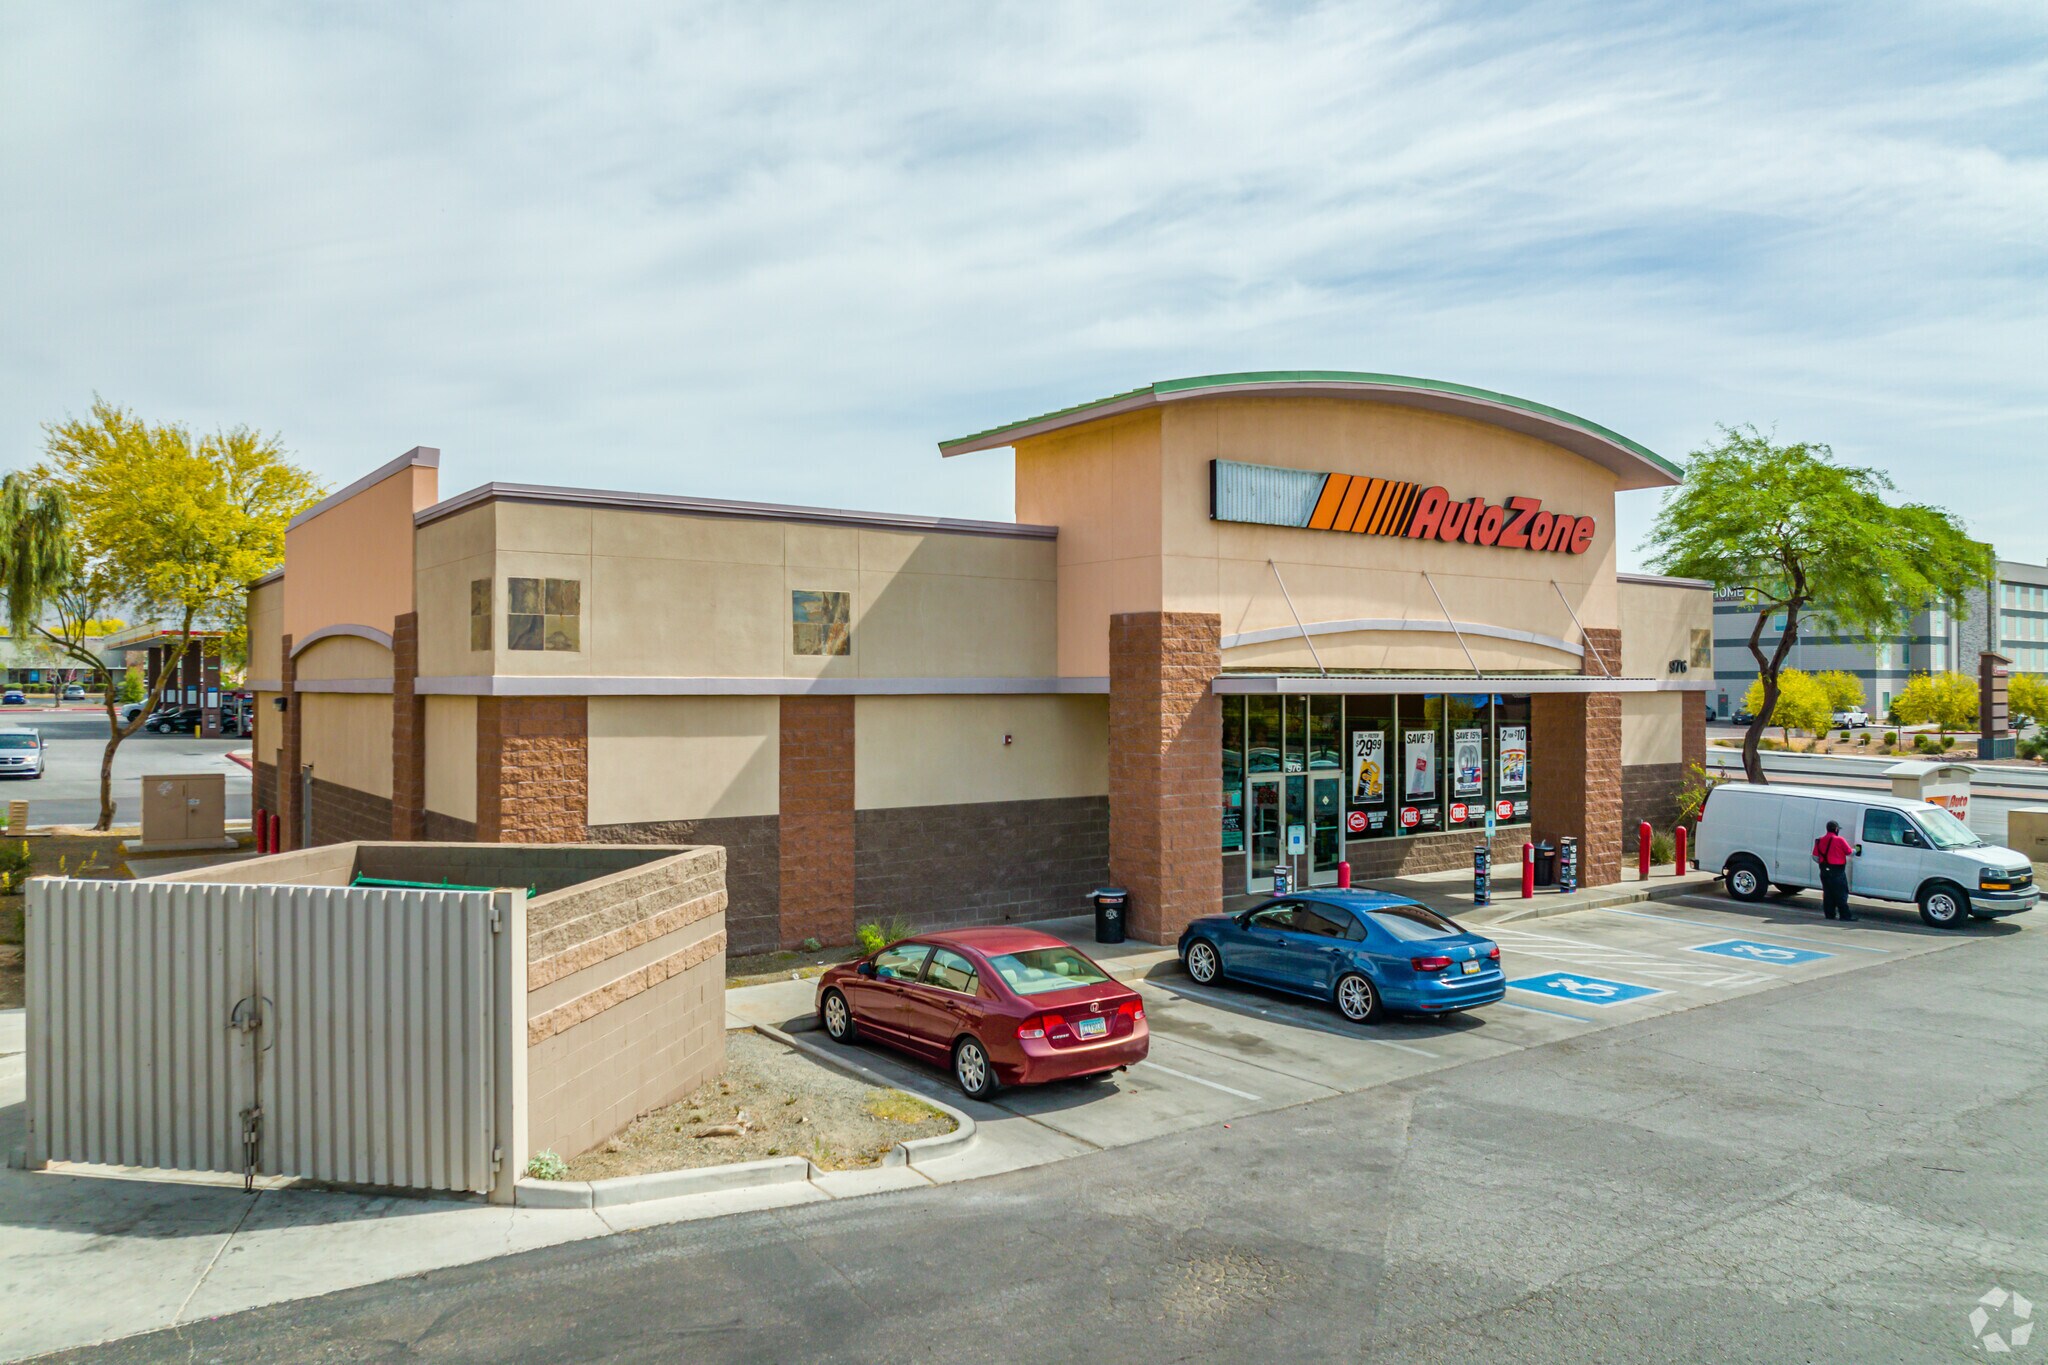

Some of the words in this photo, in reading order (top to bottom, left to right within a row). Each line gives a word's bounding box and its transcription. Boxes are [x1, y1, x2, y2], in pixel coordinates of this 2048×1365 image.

[1407, 485, 1596, 556] AutoZone
[1668, 660, 1687, 673] 976
[1407, 733, 1426, 744] SAVE
[1427, 732, 1434, 744] $1
[1456, 731, 1469, 740] SAVE
[1469, 731, 1481, 740] 15%
[1501, 729, 1508, 741] 2
[1514, 729, 1525, 741] $10
[1288, 763, 1302, 773] 976
[1949, 795, 1968, 808] Auto
[1453, 807, 1466, 819] FREE
[1499, 804, 1511, 816] FREE
[1403, 811, 1418, 823] FREE
